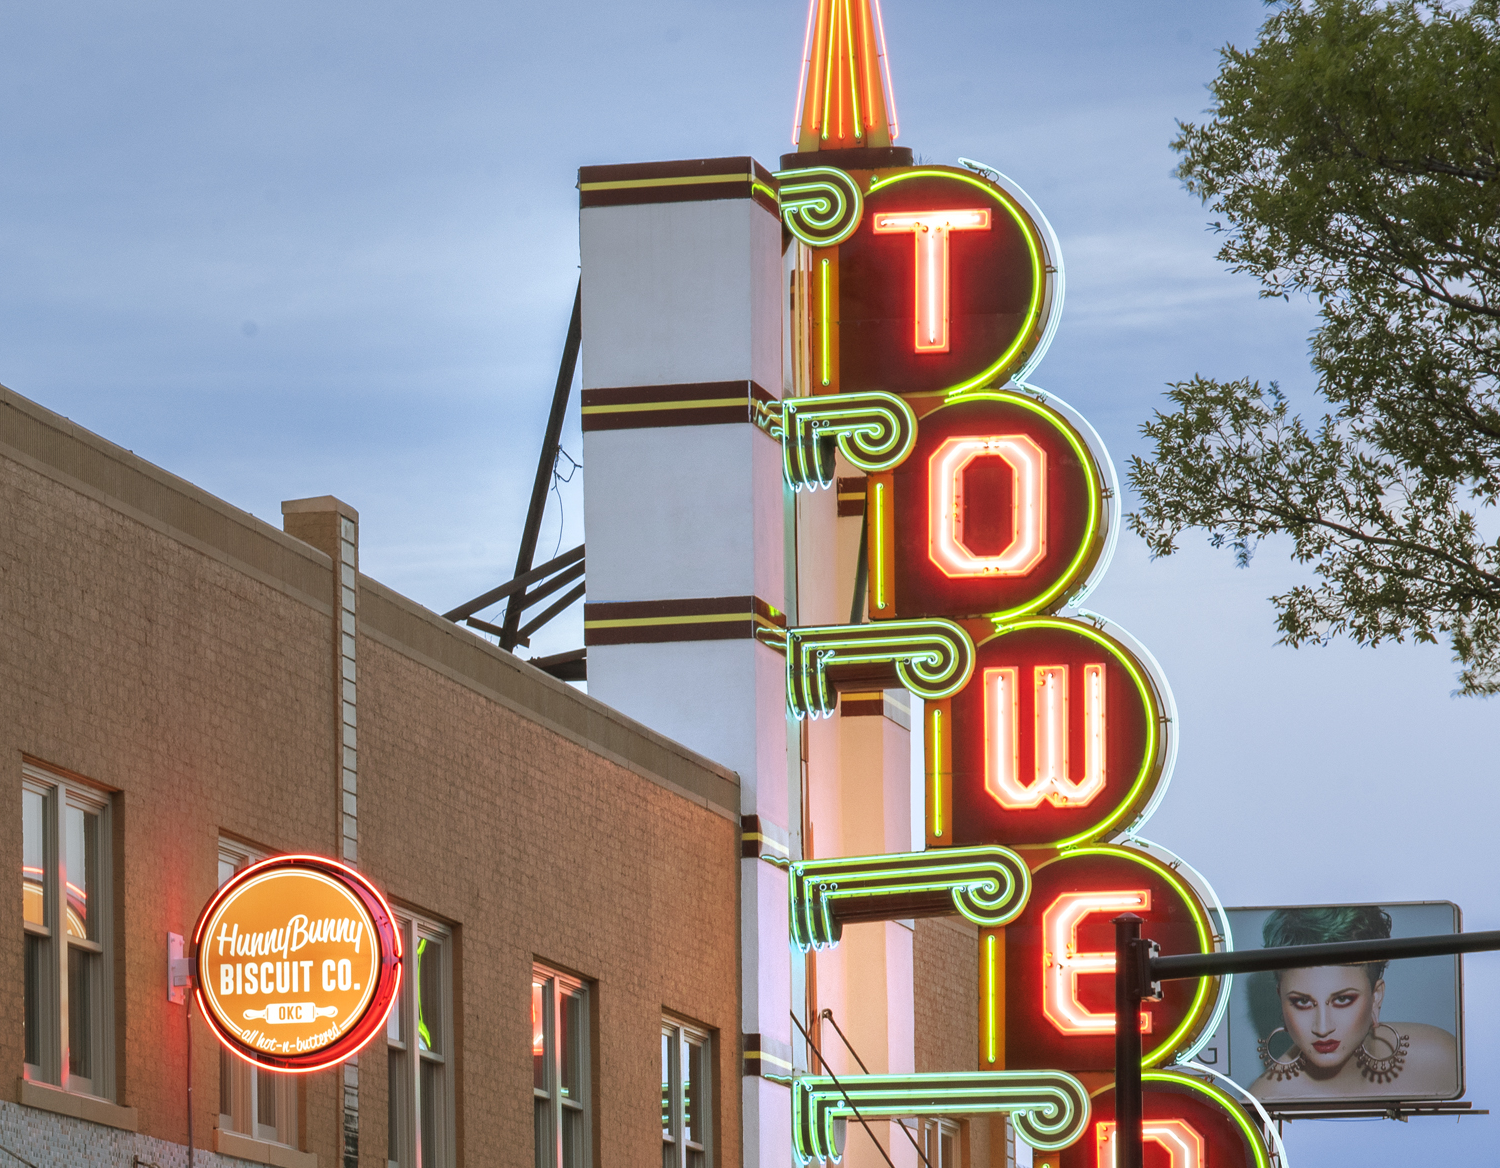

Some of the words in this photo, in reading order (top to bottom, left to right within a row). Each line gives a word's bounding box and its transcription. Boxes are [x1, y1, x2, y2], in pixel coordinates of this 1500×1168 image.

[220, 960, 313, 996] BISCUIT
[322, 958, 361, 991] CO.
[278, 1006, 303, 1021] OKC
